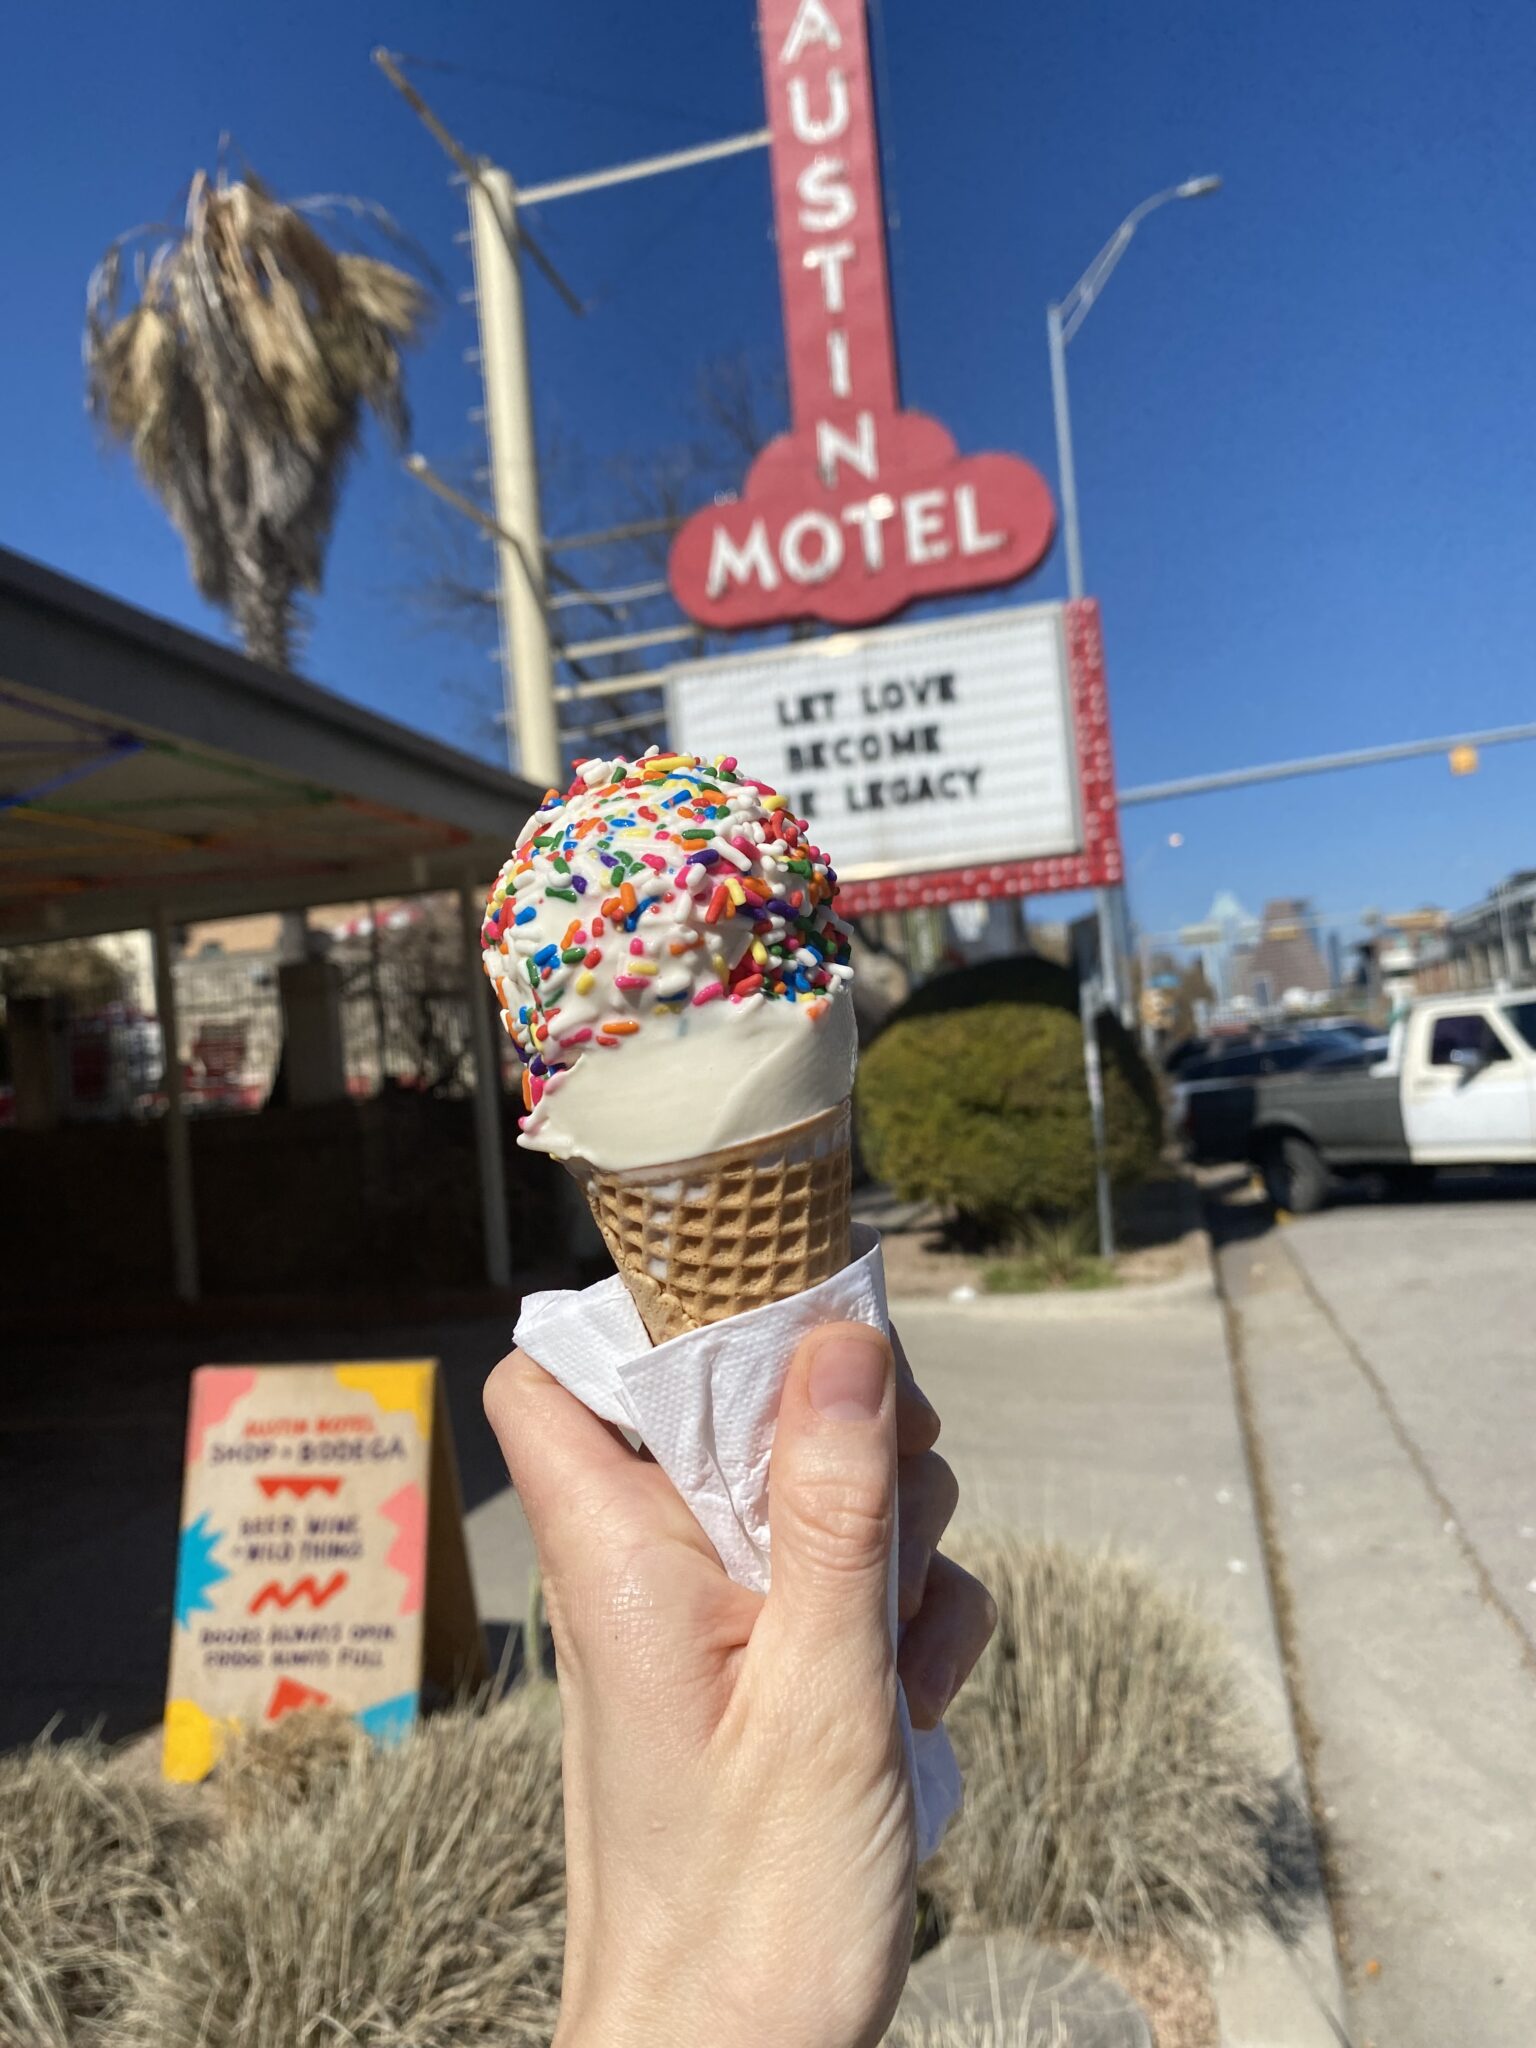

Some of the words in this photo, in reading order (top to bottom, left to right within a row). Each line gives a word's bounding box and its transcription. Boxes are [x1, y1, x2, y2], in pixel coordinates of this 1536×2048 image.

[780, 0, 879, 489] AUSTIN
[706, 484, 1006, 600] MOTEL
[778, 690, 836, 727] LET
[861, 673, 956, 715] LOVE
[787, 724, 940, 773] BECOME
[847, 768, 981, 812] LEGACY
[300, 1435, 407, 1464] BODEGA
